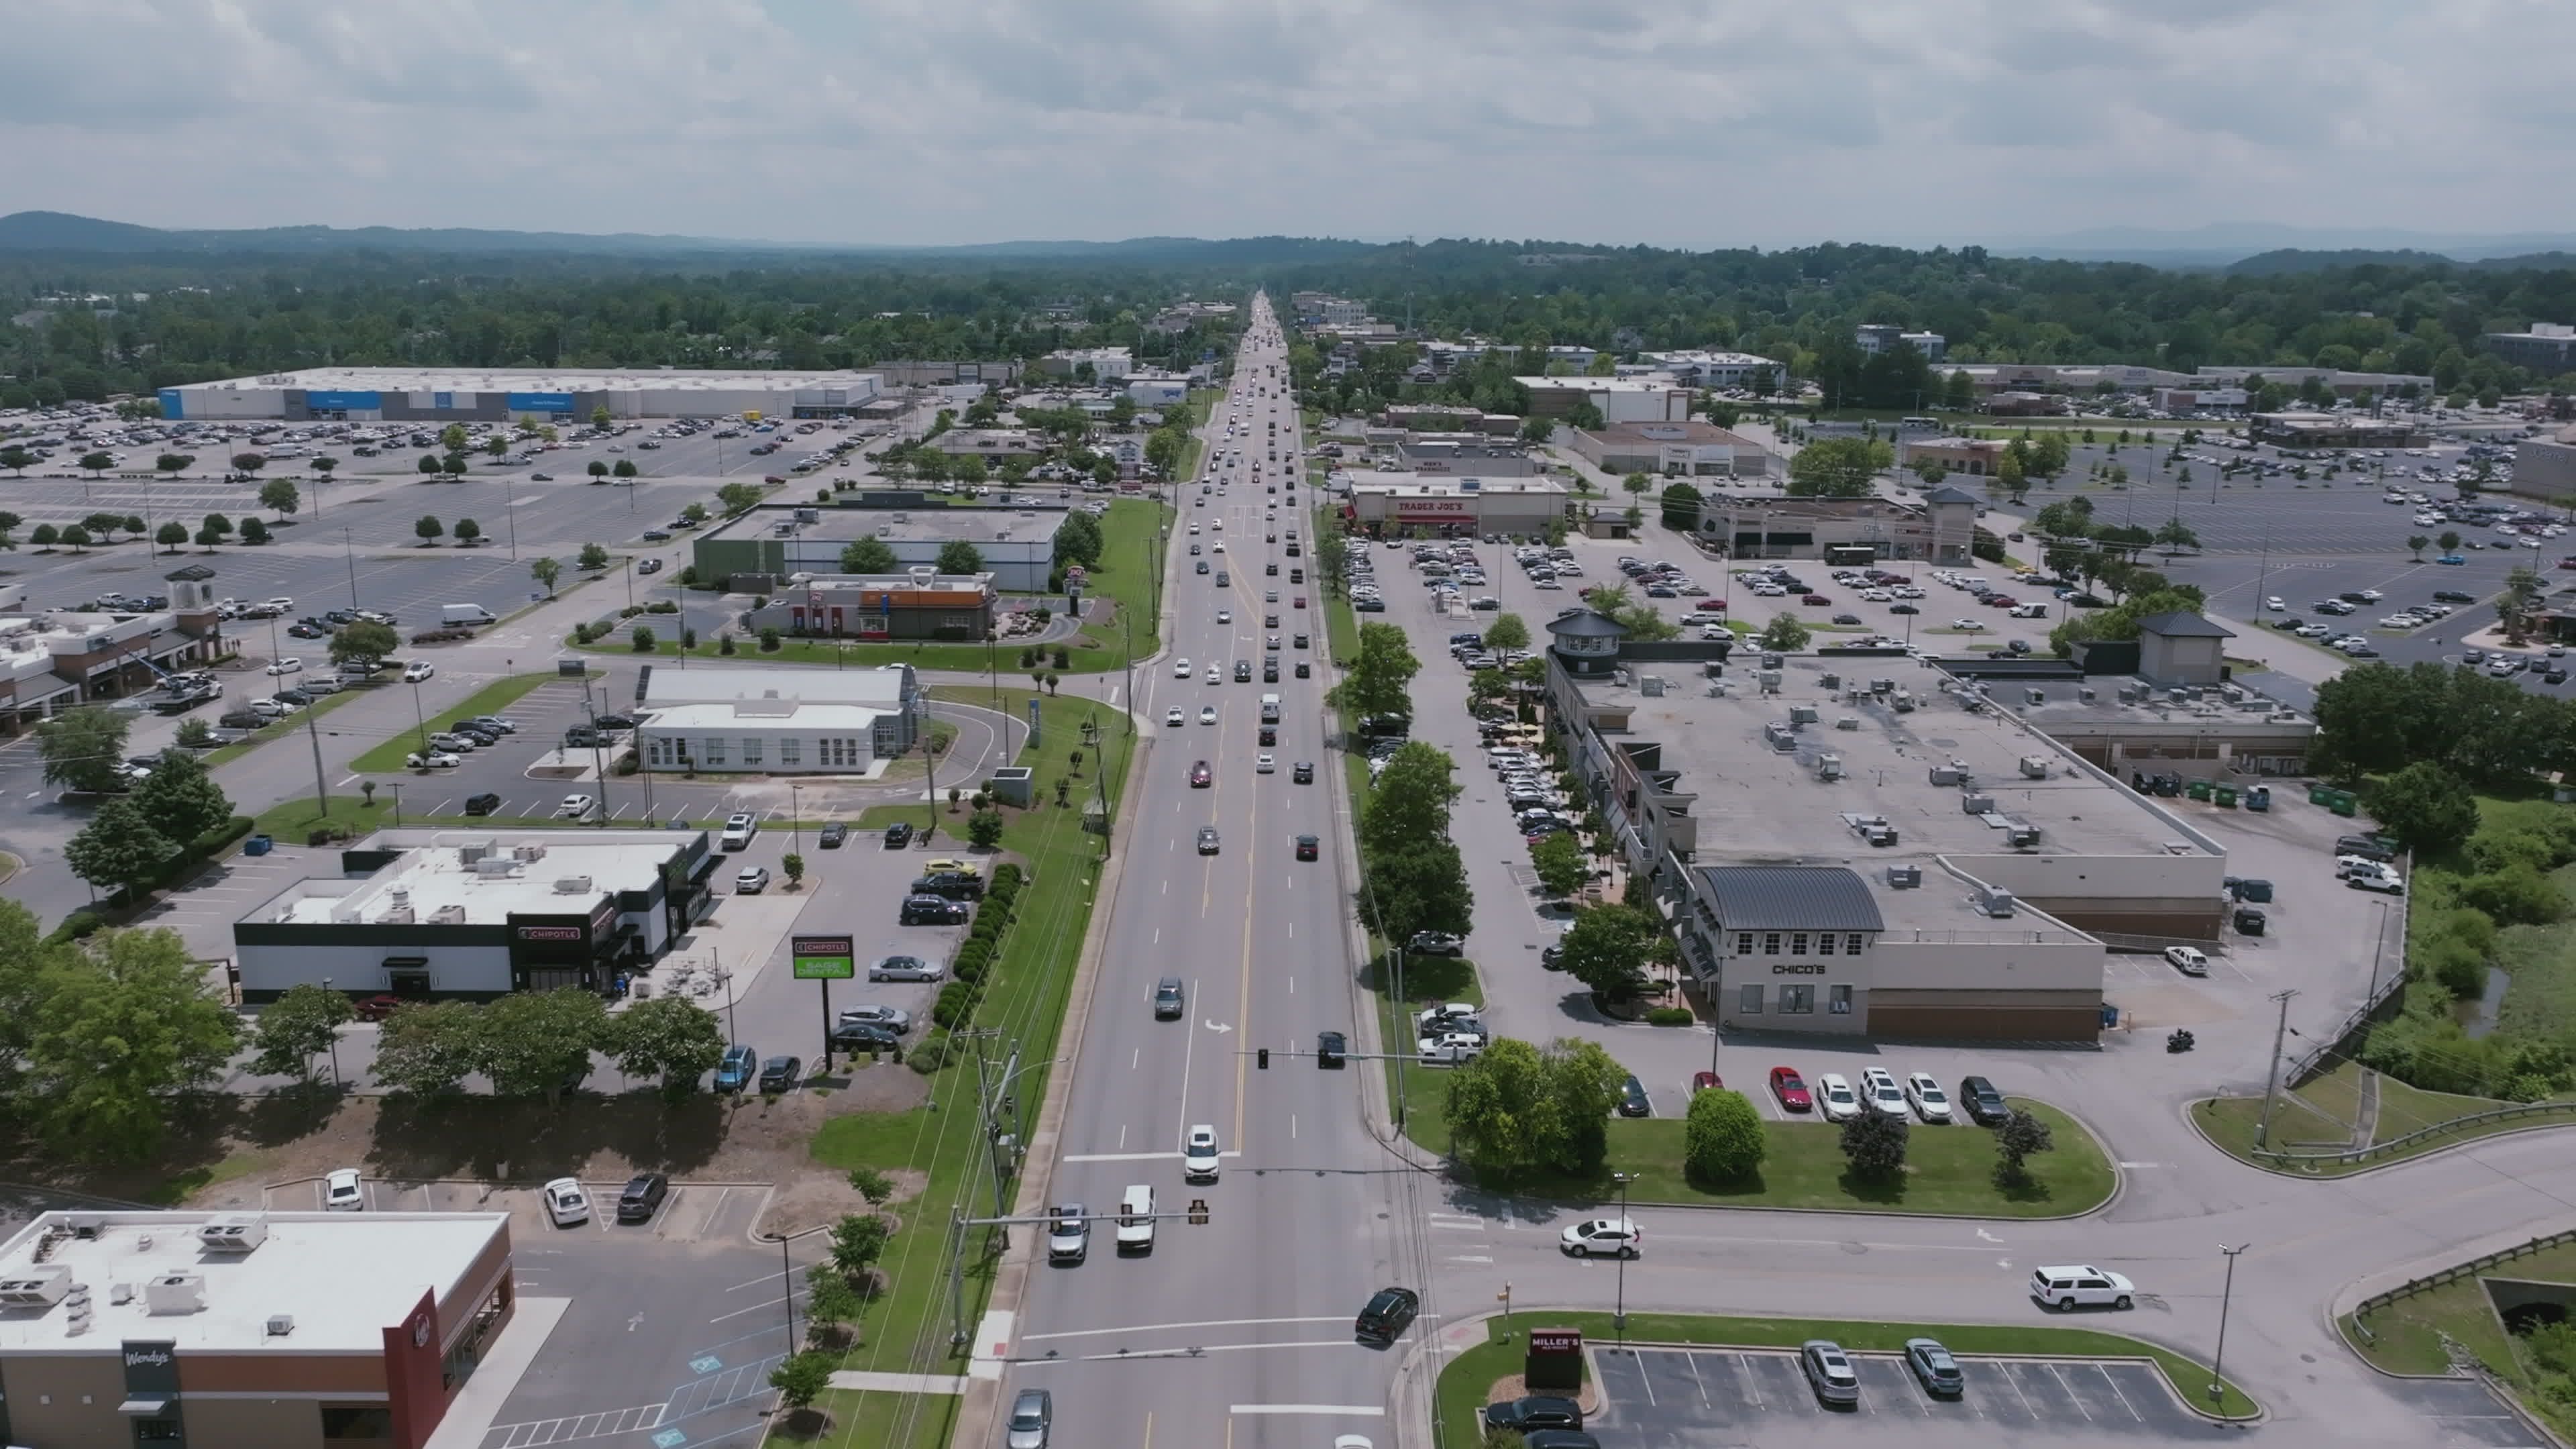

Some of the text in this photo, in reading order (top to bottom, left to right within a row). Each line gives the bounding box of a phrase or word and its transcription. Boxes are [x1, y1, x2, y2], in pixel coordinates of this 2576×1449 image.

[531, 930, 576, 938] CHIPOTLE
[1772, 965, 1825, 975] CHICO'S
[125, 1350, 169, 1366] Wendy's
